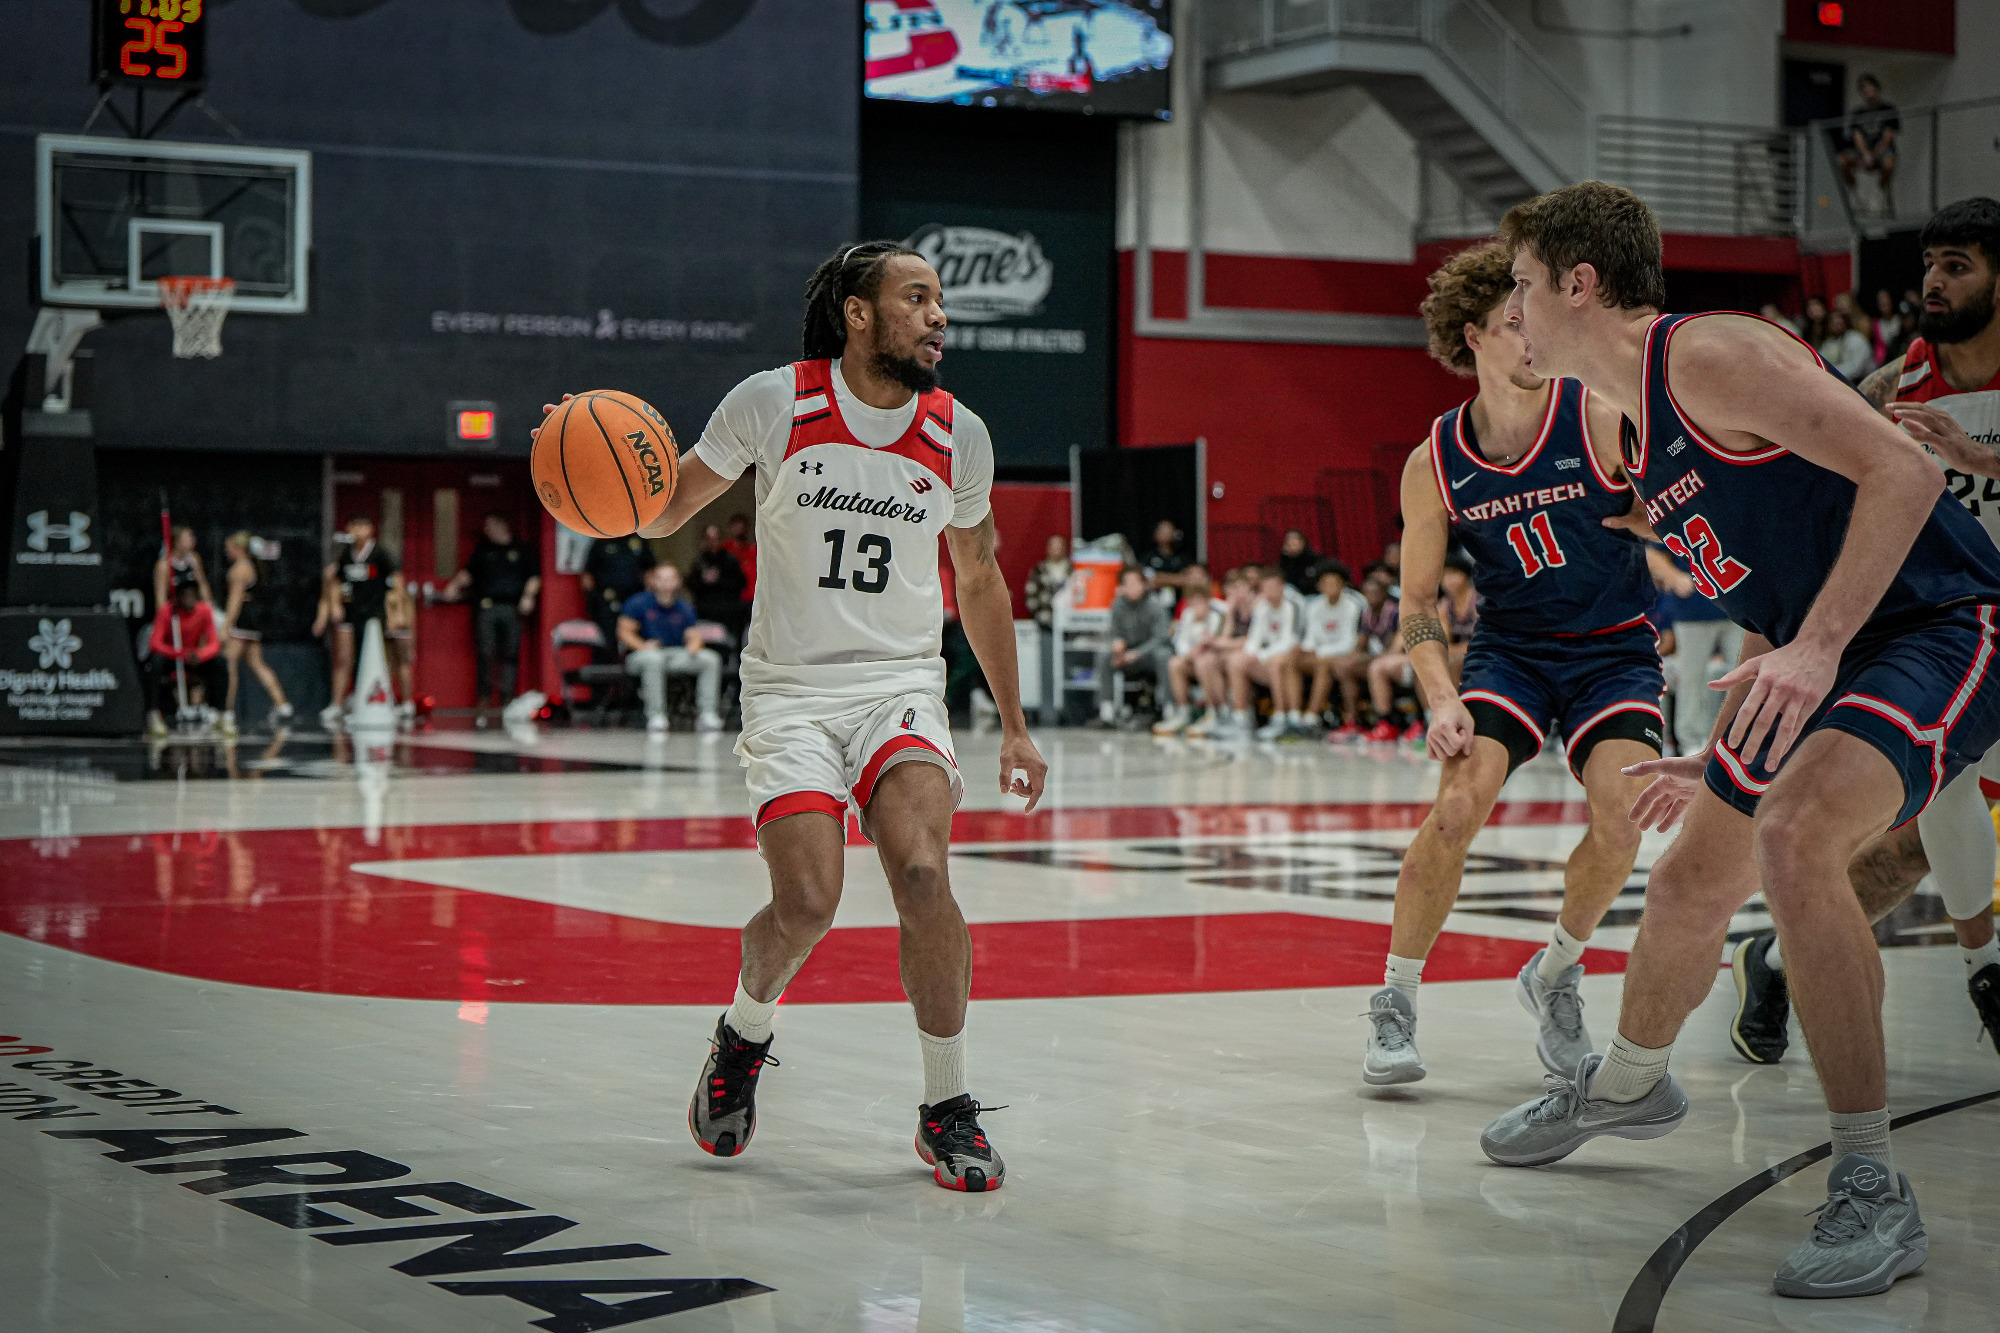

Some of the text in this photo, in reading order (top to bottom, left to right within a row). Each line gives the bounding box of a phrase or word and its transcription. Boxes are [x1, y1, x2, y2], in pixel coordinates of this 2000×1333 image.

[121, 17, 187, 79] 25
[625, 430, 665, 498] NCAA
[1554, 457, 1581, 471] WAC
[1656, 468, 1706, 512] TECH
[796, 486, 928, 524] Matadors
[1462, 482, 1587, 521] UTAH TECH
[818, 528, 892, 594] 13
[1506, 510, 1567, 579] 11
[0, 669, 57, 694] Dignity
[11, 1060, 244, 1116] CREDIT
[40, 1127, 778, 1333] ARENA
